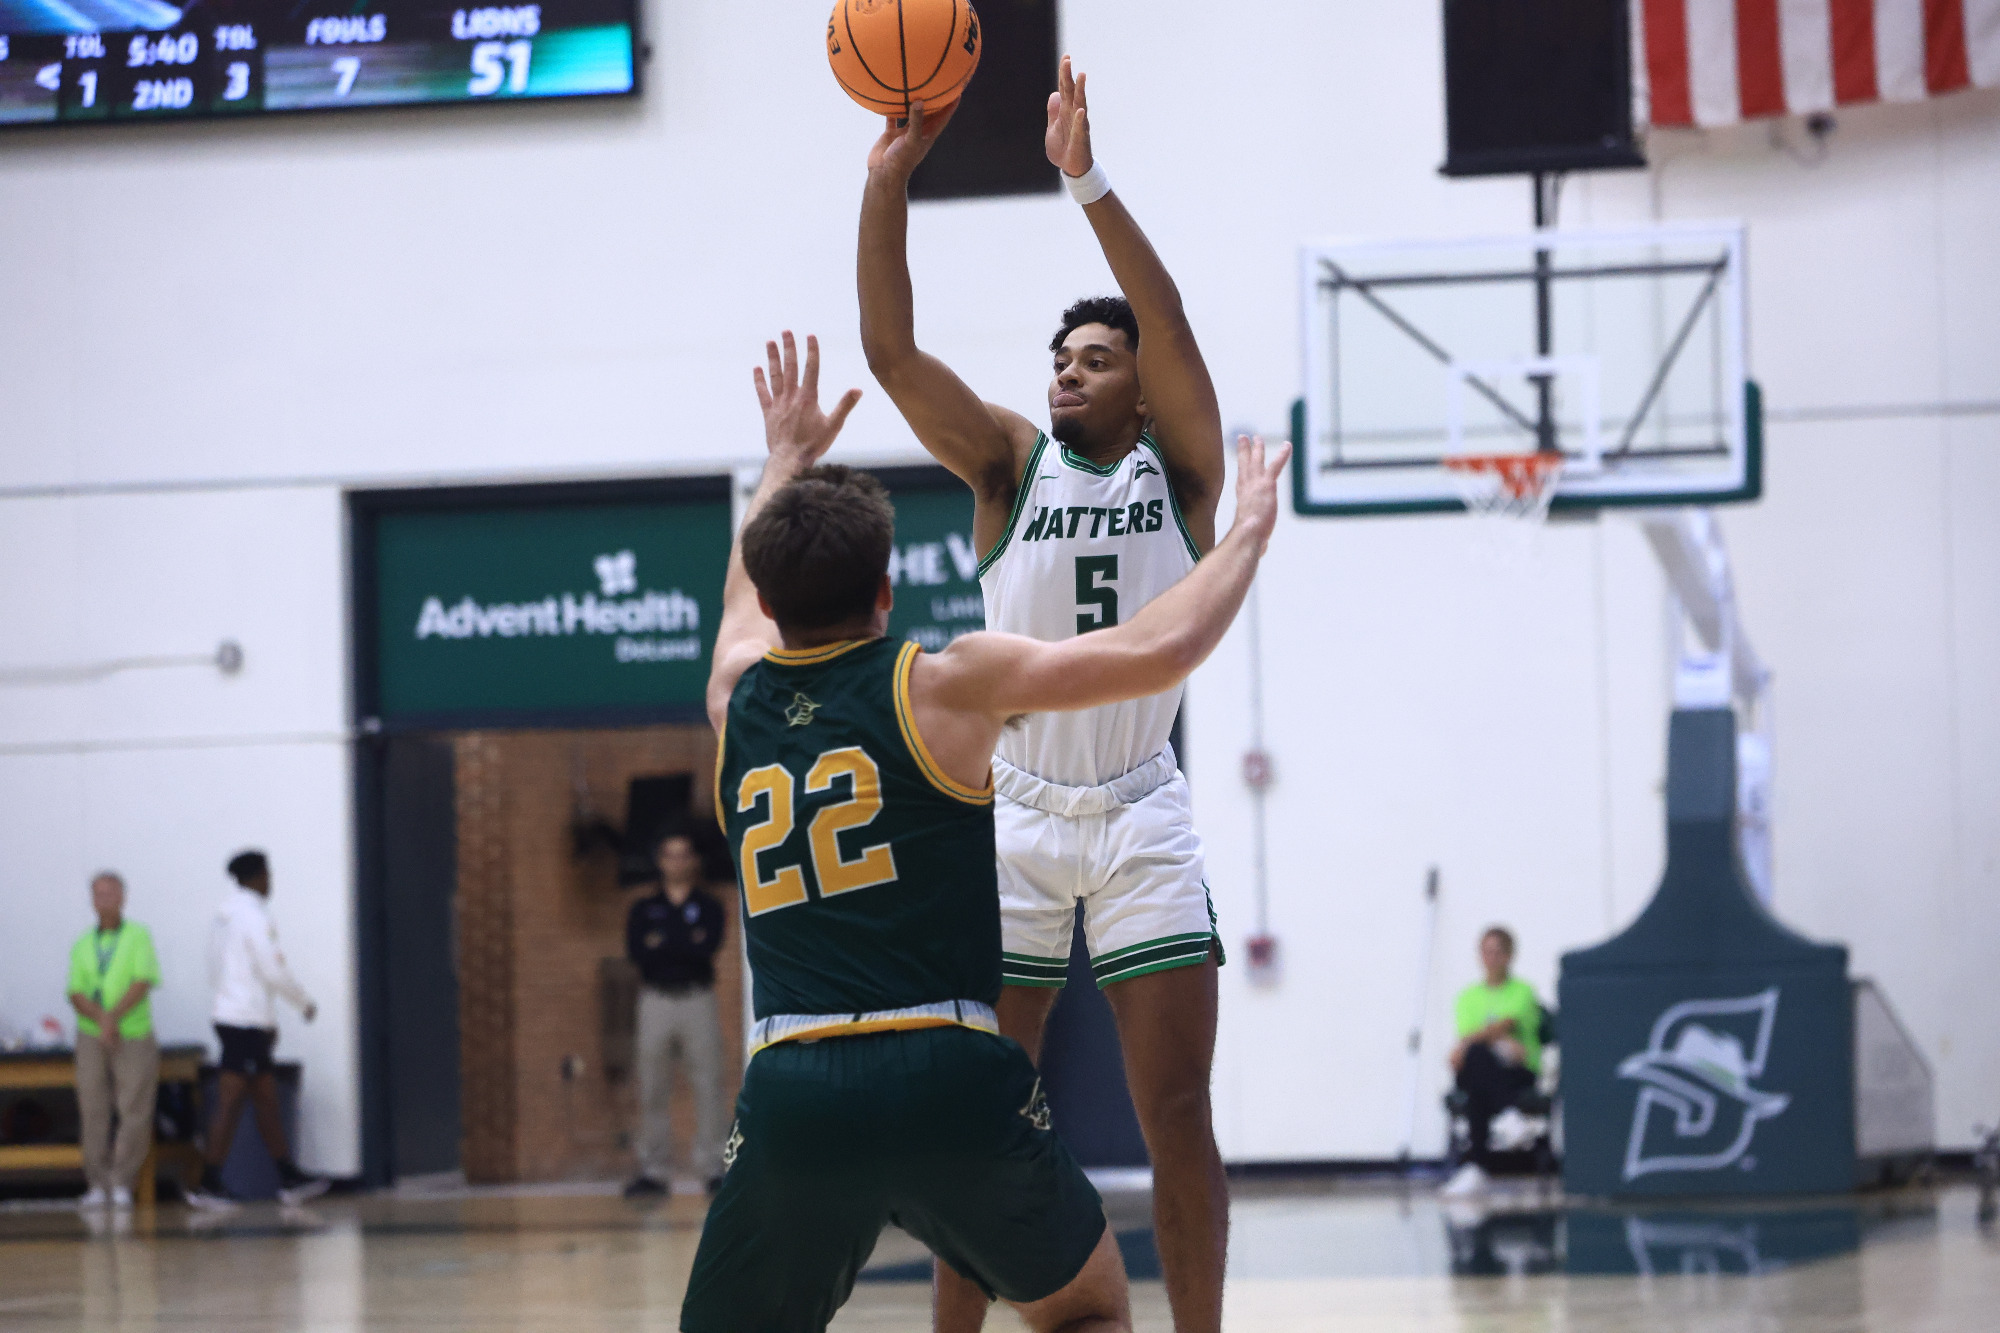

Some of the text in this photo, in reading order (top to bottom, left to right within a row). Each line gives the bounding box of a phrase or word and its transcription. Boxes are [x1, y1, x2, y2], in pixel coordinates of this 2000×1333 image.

[306, 13, 386, 45] FOULS
[452, 4, 541, 40] LIONS
[126, 32, 198, 67] 5:40
[467, 40, 532, 96] 51
[78, 70, 98, 108] 1
[132, 77, 194, 110] 2ND
[223, 62, 250, 100] 3
[331, 56, 361, 97] 7
[1075, 554, 1118, 635] 5
[416, 588, 700, 640] AdventHealth
[737, 745, 898, 918] 22
